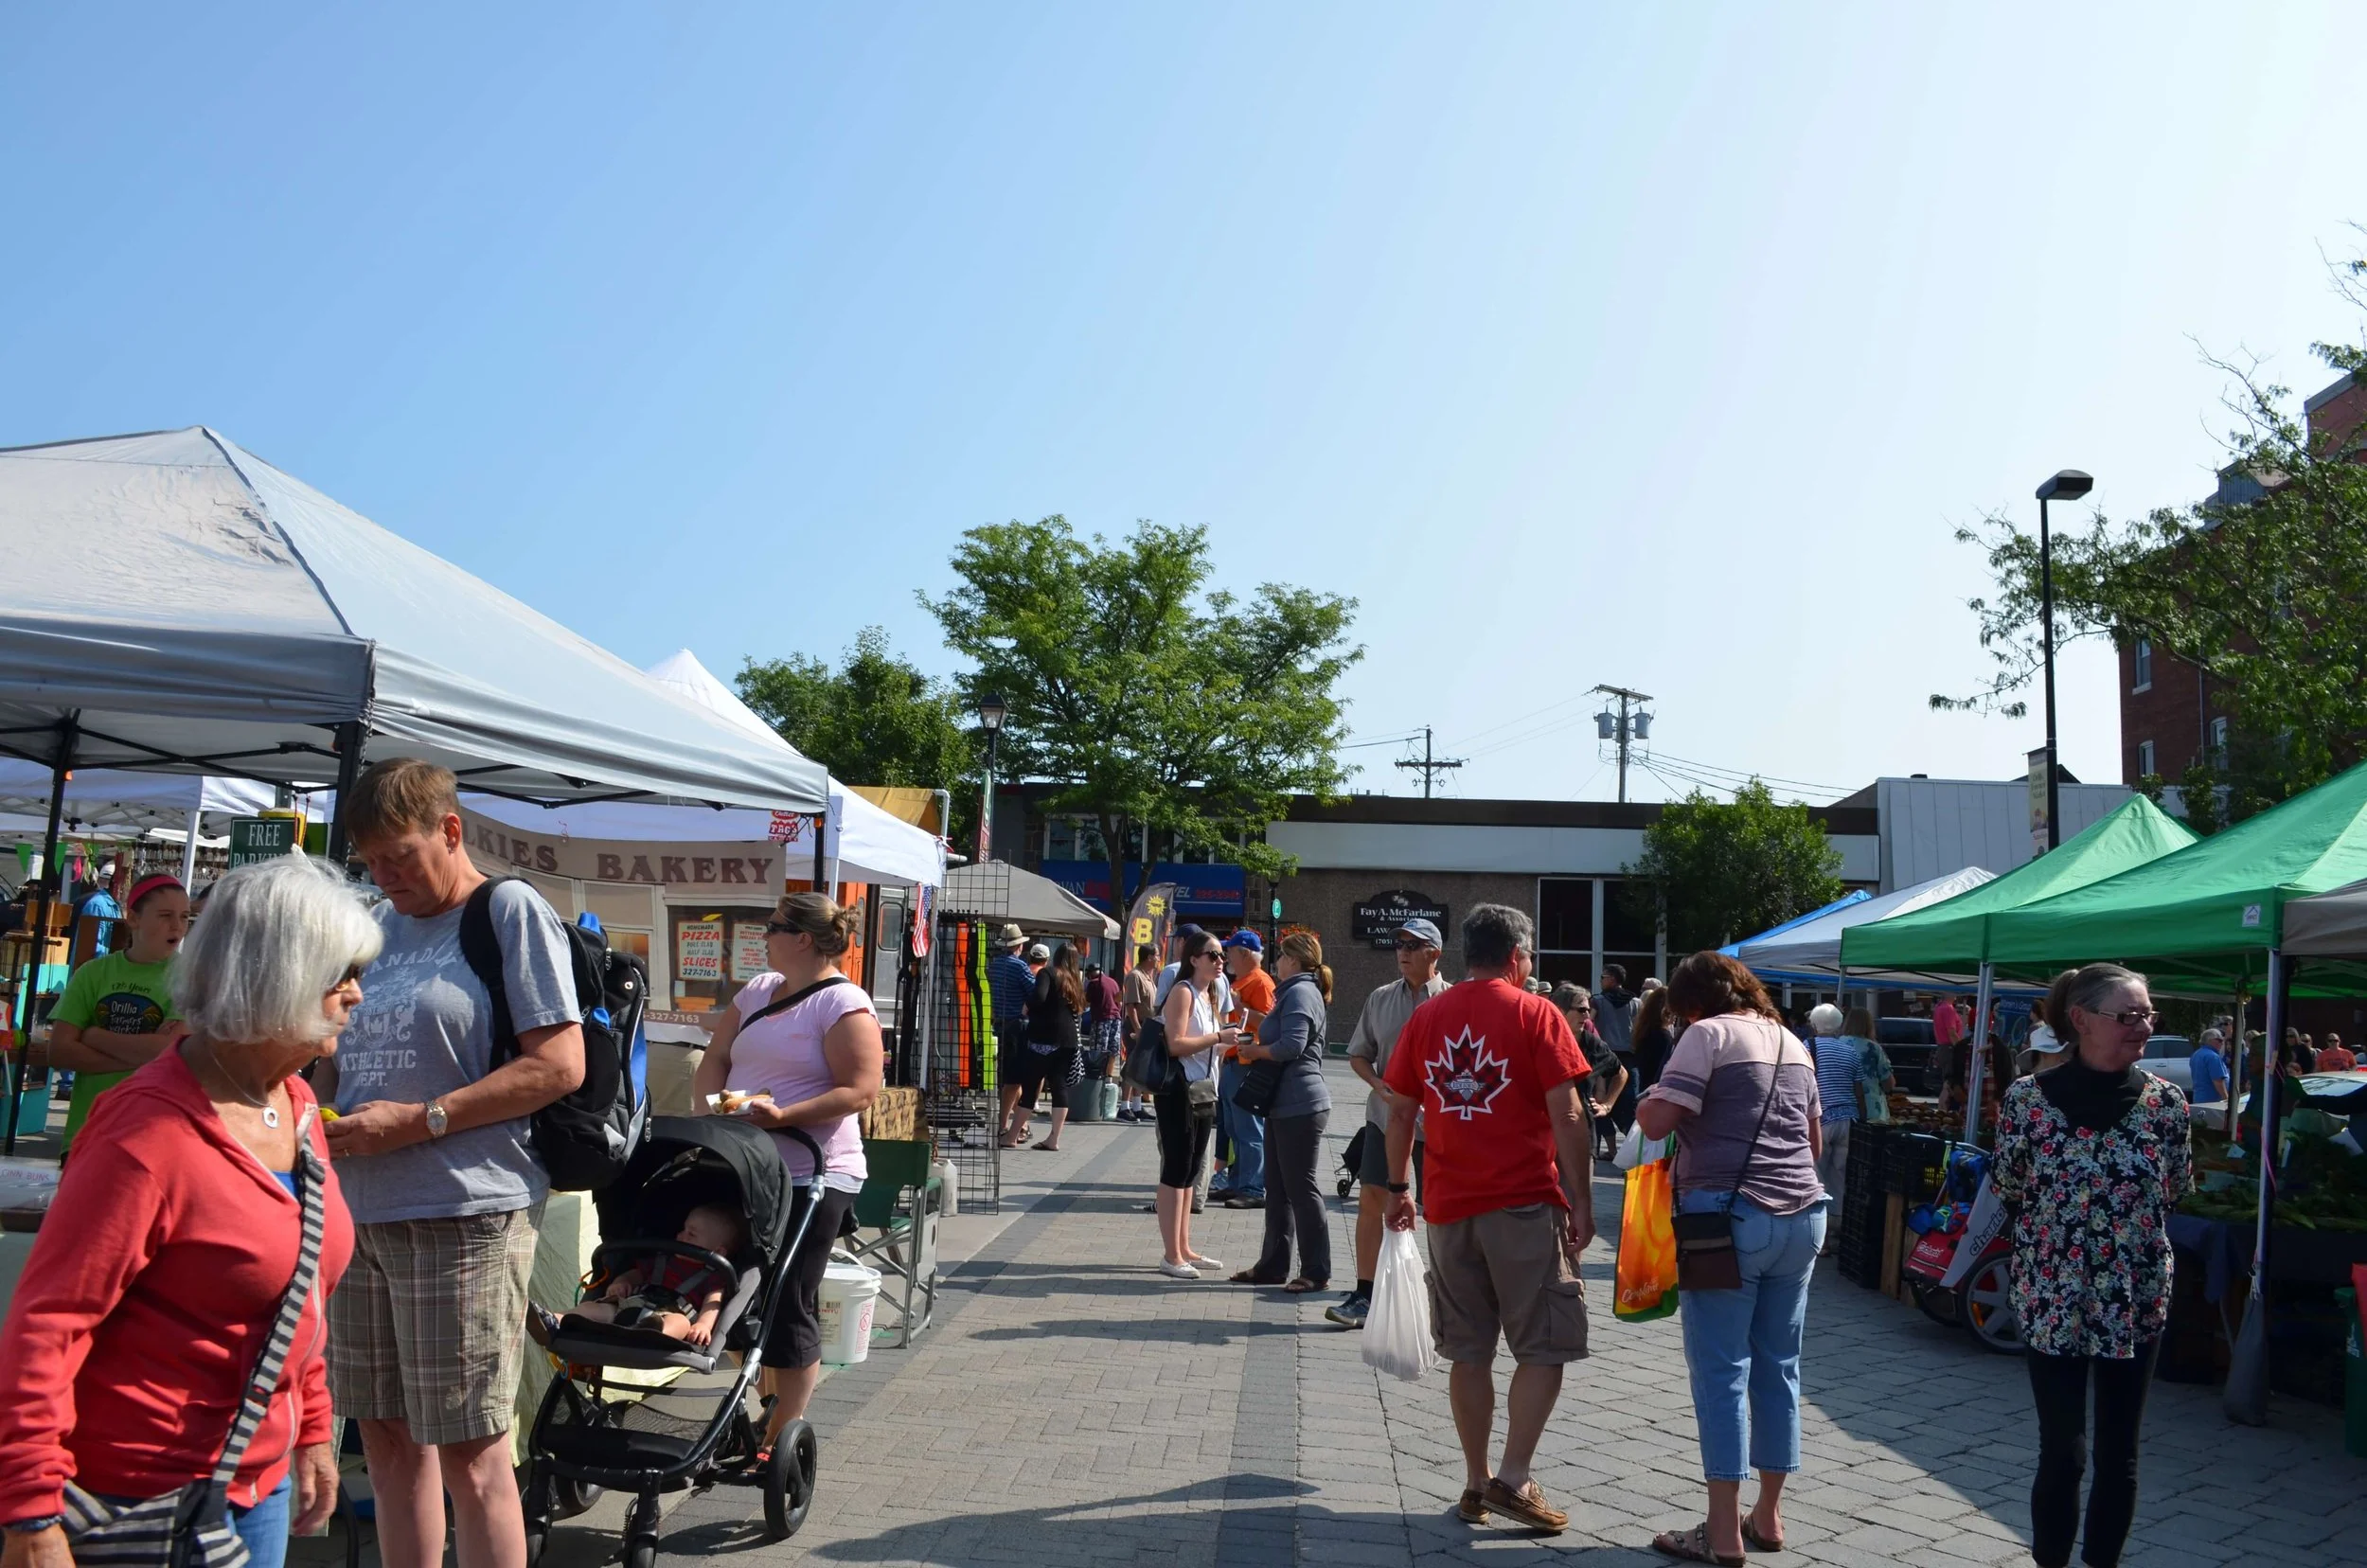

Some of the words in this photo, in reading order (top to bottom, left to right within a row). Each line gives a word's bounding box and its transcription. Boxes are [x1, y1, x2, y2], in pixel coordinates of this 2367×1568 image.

[248, 824, 281, 846] FREE
[596, 852, 774, 885] BAKERY
[1360, 907, 1377, 918] Fay
[1378, 908, 1389, 917] A.
[1390, 908, 1442, 918] McFarlane
[682, 931, 720, 941] PIZZA
[683, 956, 718, 968] SLICES
[682, 968, 717, 977] 327-7163
[111, 1001, 138, 1015] Orillia
[340, 1049, 418, 1073] ATHLETIC
